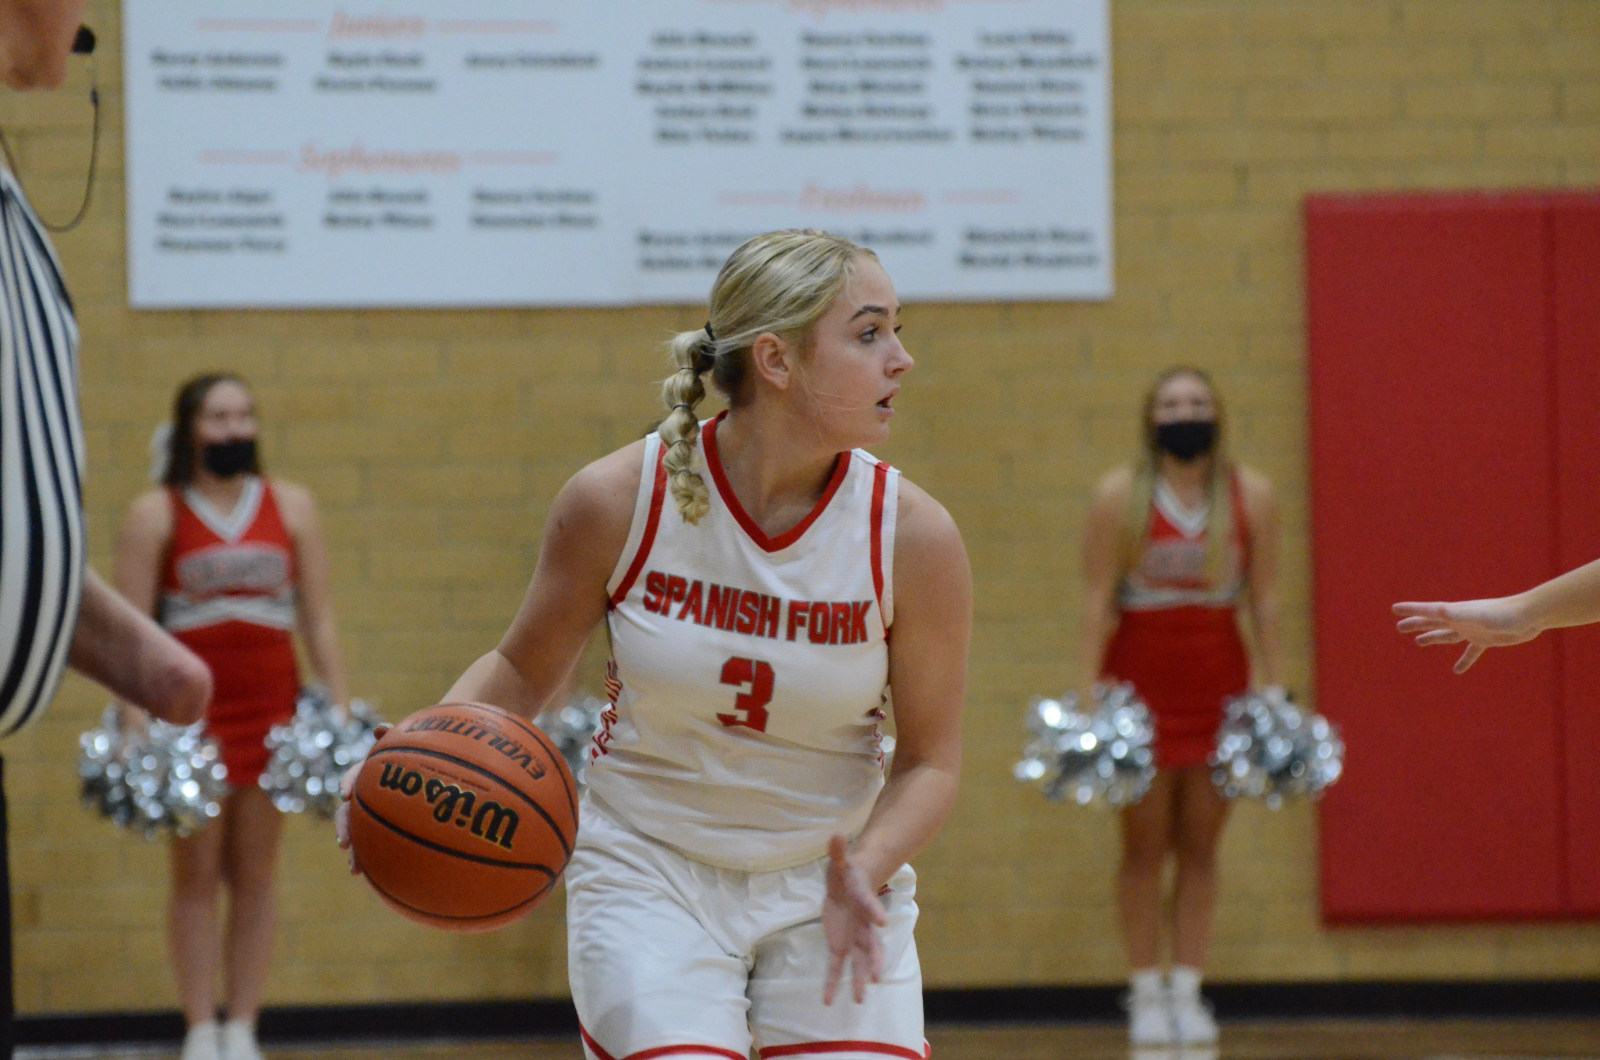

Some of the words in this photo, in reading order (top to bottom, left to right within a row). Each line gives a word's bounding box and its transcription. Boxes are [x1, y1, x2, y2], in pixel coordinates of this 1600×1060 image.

[643, 570, 781, 640] SPANISH
[786, 600, 873, 645] FORK
[716, 656, 775, 732] 3
[405, 715, 546, 781] EVOLUTION
[379, 761, 519, 850] Wilson
